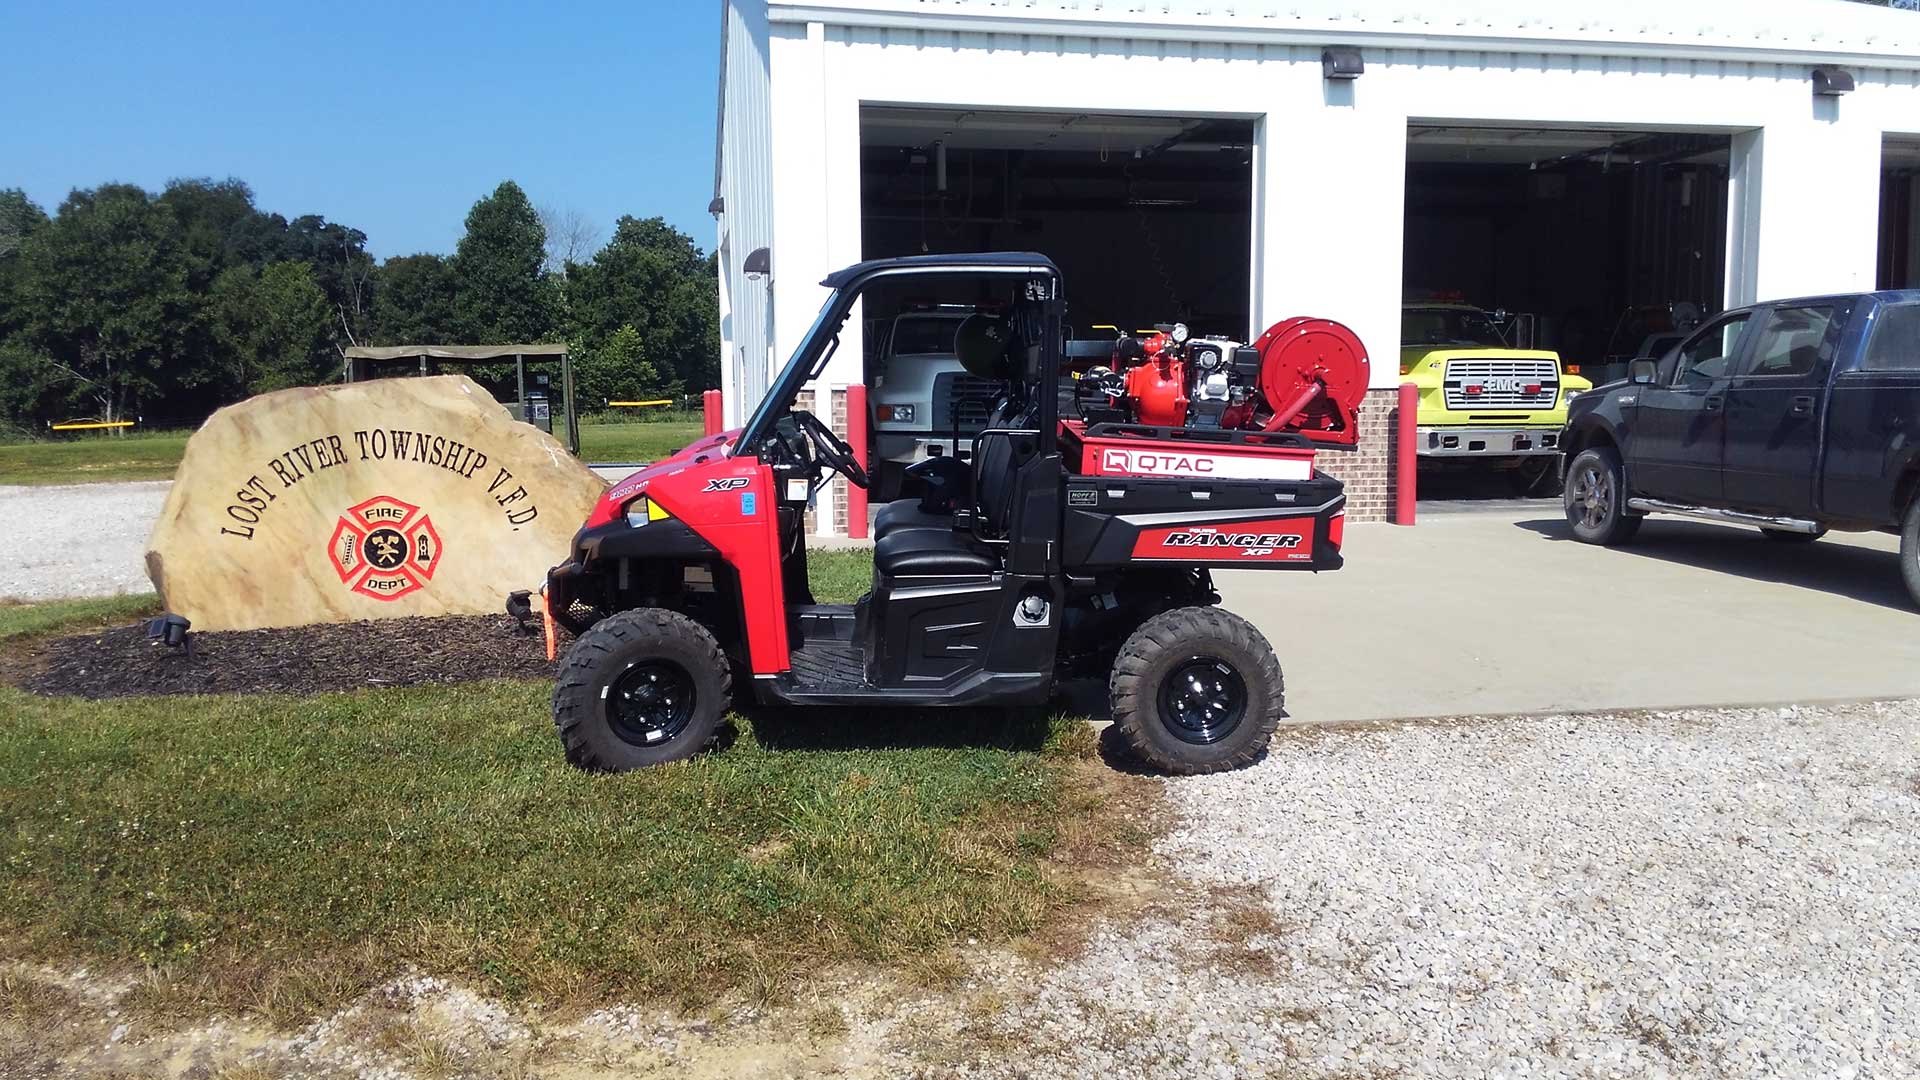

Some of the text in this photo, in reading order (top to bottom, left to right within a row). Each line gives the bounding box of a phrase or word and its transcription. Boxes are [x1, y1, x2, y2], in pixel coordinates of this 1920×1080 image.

[1138, 455, 1214, 472] QTAC
[221, 475, 277, 540] LOST
[268, 434, 348, 488] RIVER
[354, 428, 488, 480] TOWNSHIP
[702, 477, 750, 492] XP
[364, 507, 403, 521] FIRE
[1162, 532, 1303, 548] RANGER
[1241, 548, 1273, 556] XP
